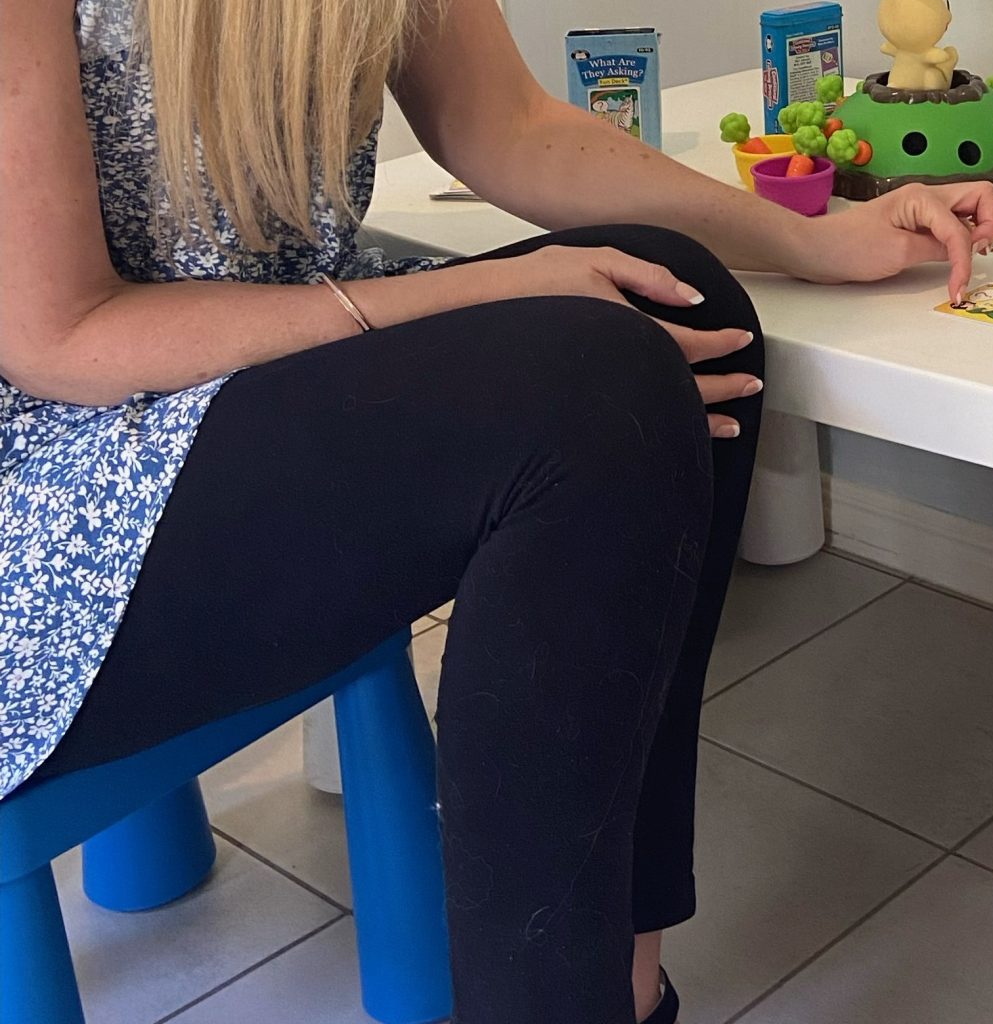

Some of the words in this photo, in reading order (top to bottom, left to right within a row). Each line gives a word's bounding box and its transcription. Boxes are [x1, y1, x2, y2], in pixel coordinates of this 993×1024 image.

[589, 58, 615, 68] What
[618, 58, 636, 67] Are
[582, 69, 605, 80] They
[608, 66, 644, 78] Asking?
